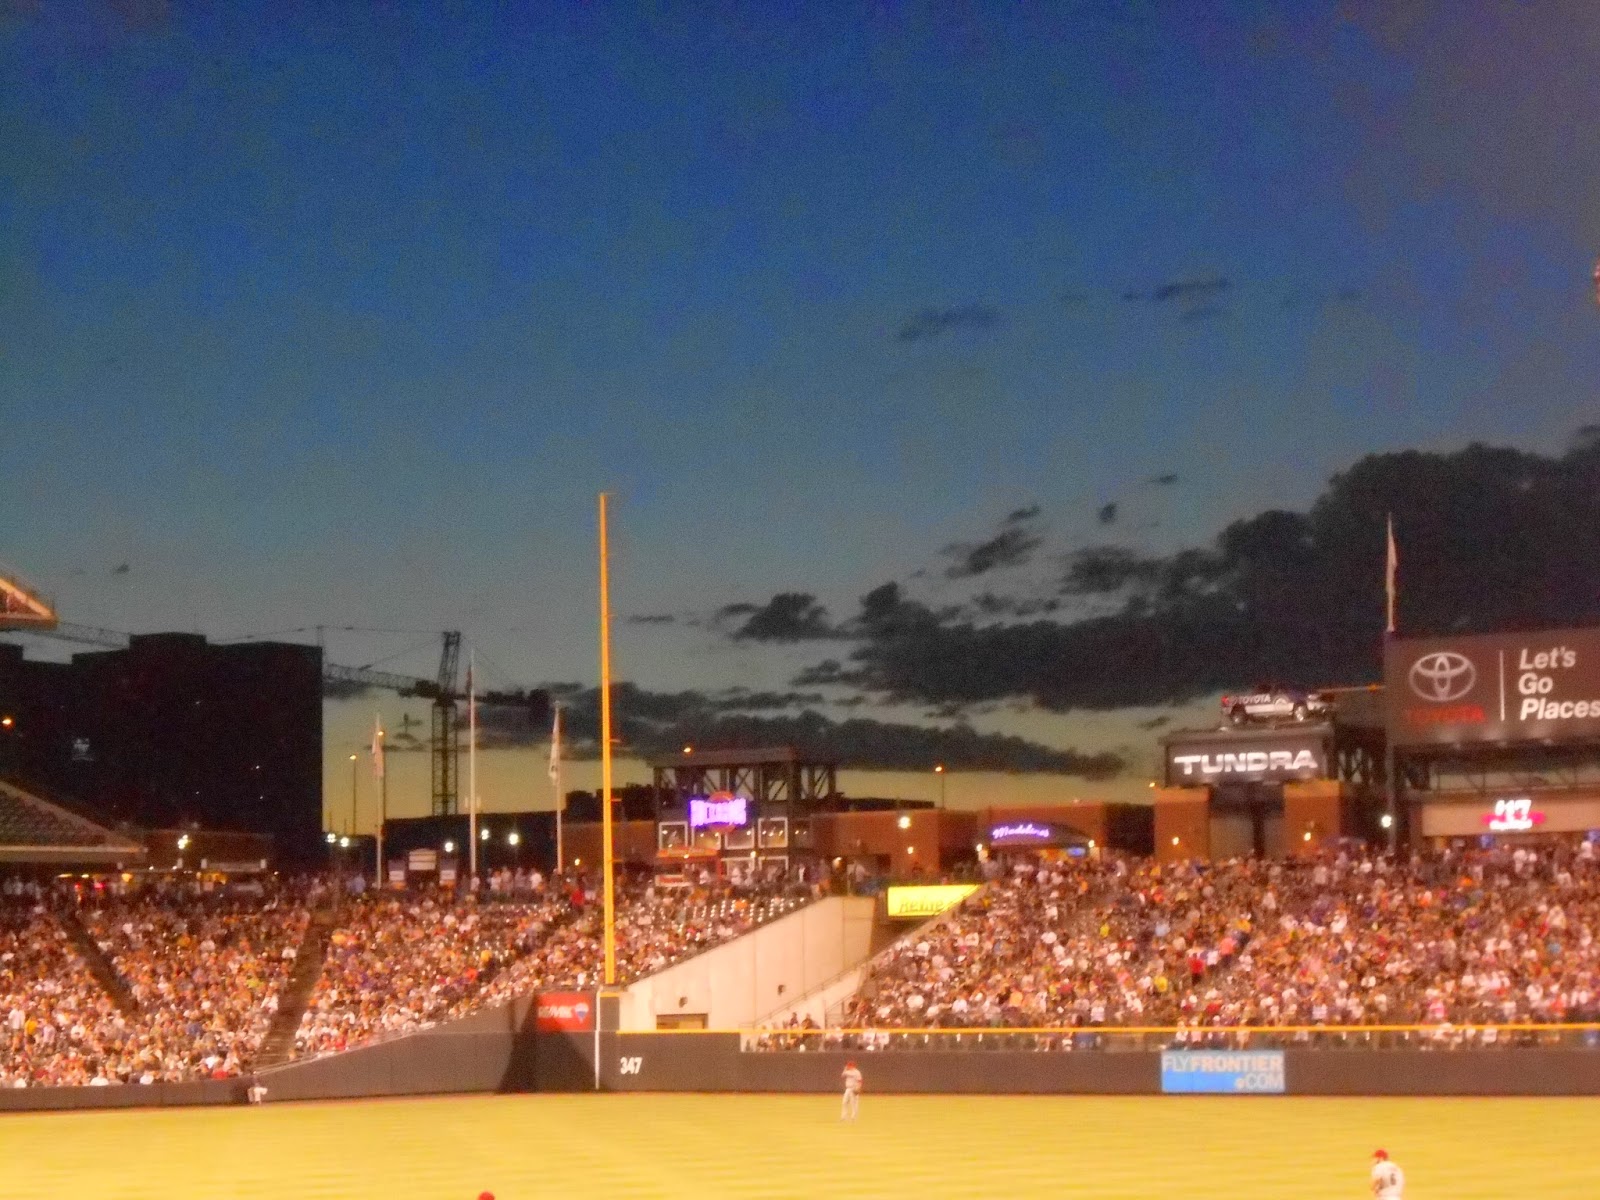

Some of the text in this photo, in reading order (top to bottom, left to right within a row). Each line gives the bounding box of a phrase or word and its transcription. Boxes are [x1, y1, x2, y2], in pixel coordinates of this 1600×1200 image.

[1518, 646, 1577, 669] Let's
[1518, 671, 1554, 694] Go
[1519, 697, 1600, 721] Places
[1173, 749, 1319, 775] TUNDRA
[619, 1056, 643, 1075] 347
